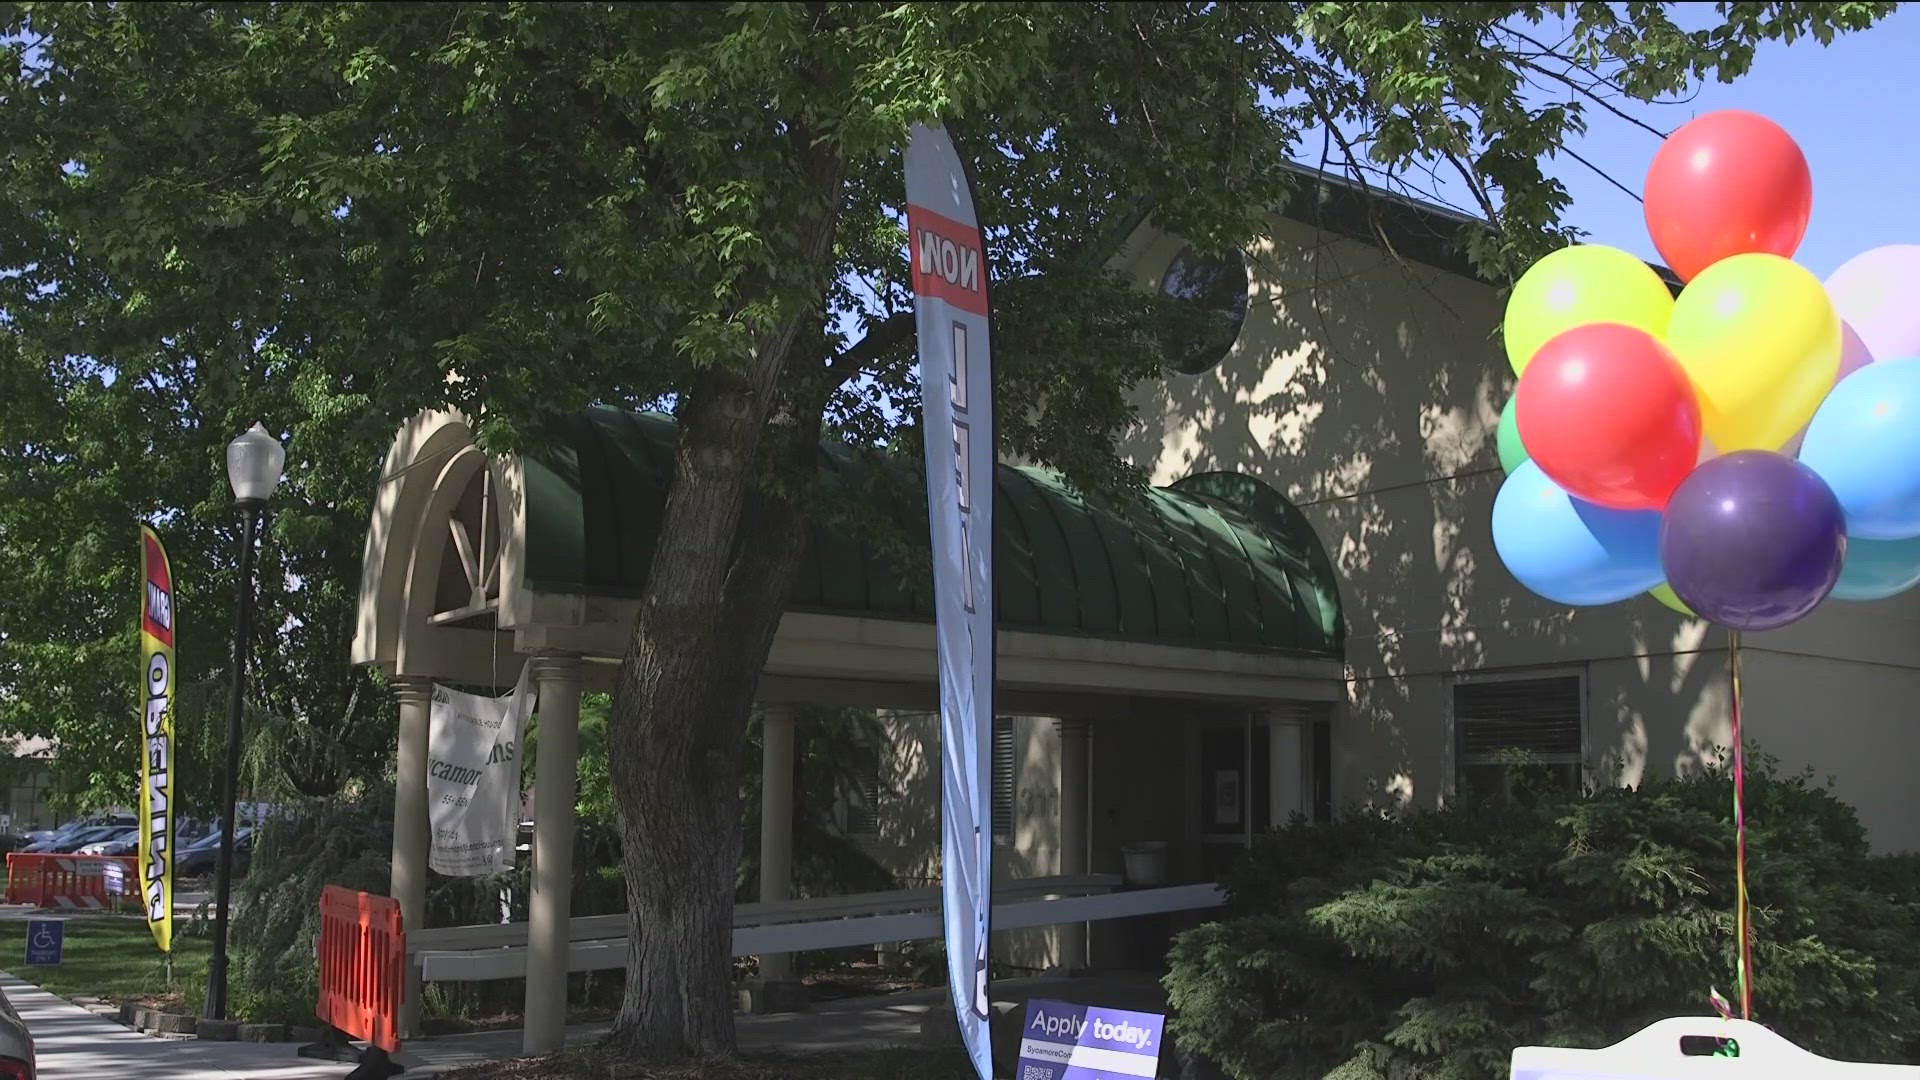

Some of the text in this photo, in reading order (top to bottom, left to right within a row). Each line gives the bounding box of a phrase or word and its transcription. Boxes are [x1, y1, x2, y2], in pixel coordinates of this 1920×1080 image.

[429, 758, 482, 785] camor
[1031, 1010, 1152, 1050] Apply today.
